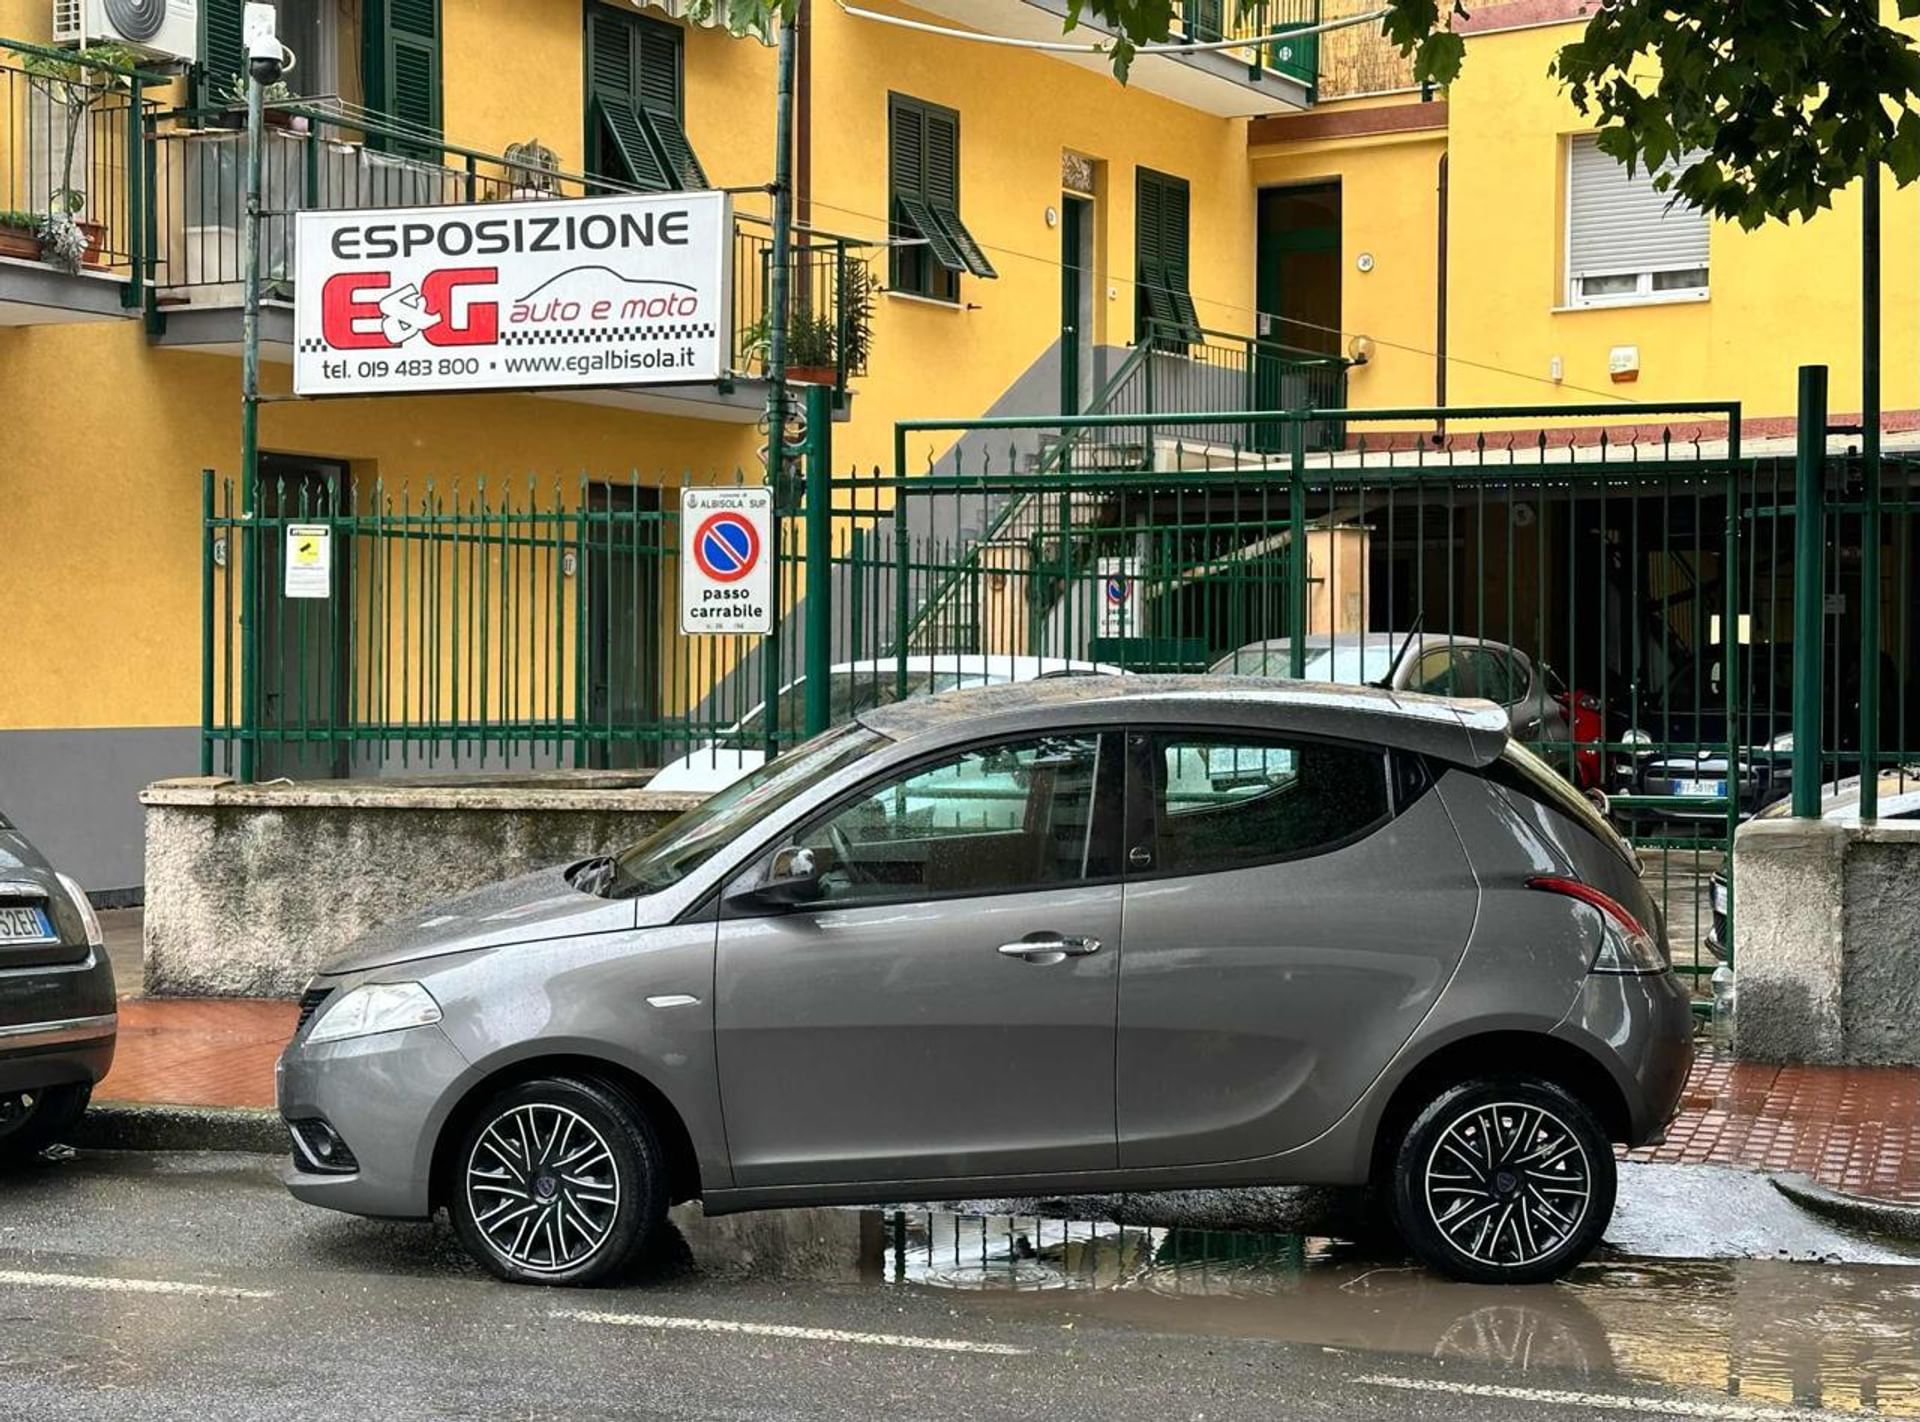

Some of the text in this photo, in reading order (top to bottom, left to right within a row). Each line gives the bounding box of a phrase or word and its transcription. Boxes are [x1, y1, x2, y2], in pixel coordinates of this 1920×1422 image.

[331, 211, 689, 260] ESPOSIZIONE
[322, 266, 499, 351] E&G
[510, 293, 698, 323] auto e moto
[322, 346, 695, 379] tel. 019 483 800 www.egalbisola.it
[701, 500, 744, 509] ALBISOLA
[703, 588, 750, 602] passo
[690, 603, 763, 618] carrabile
